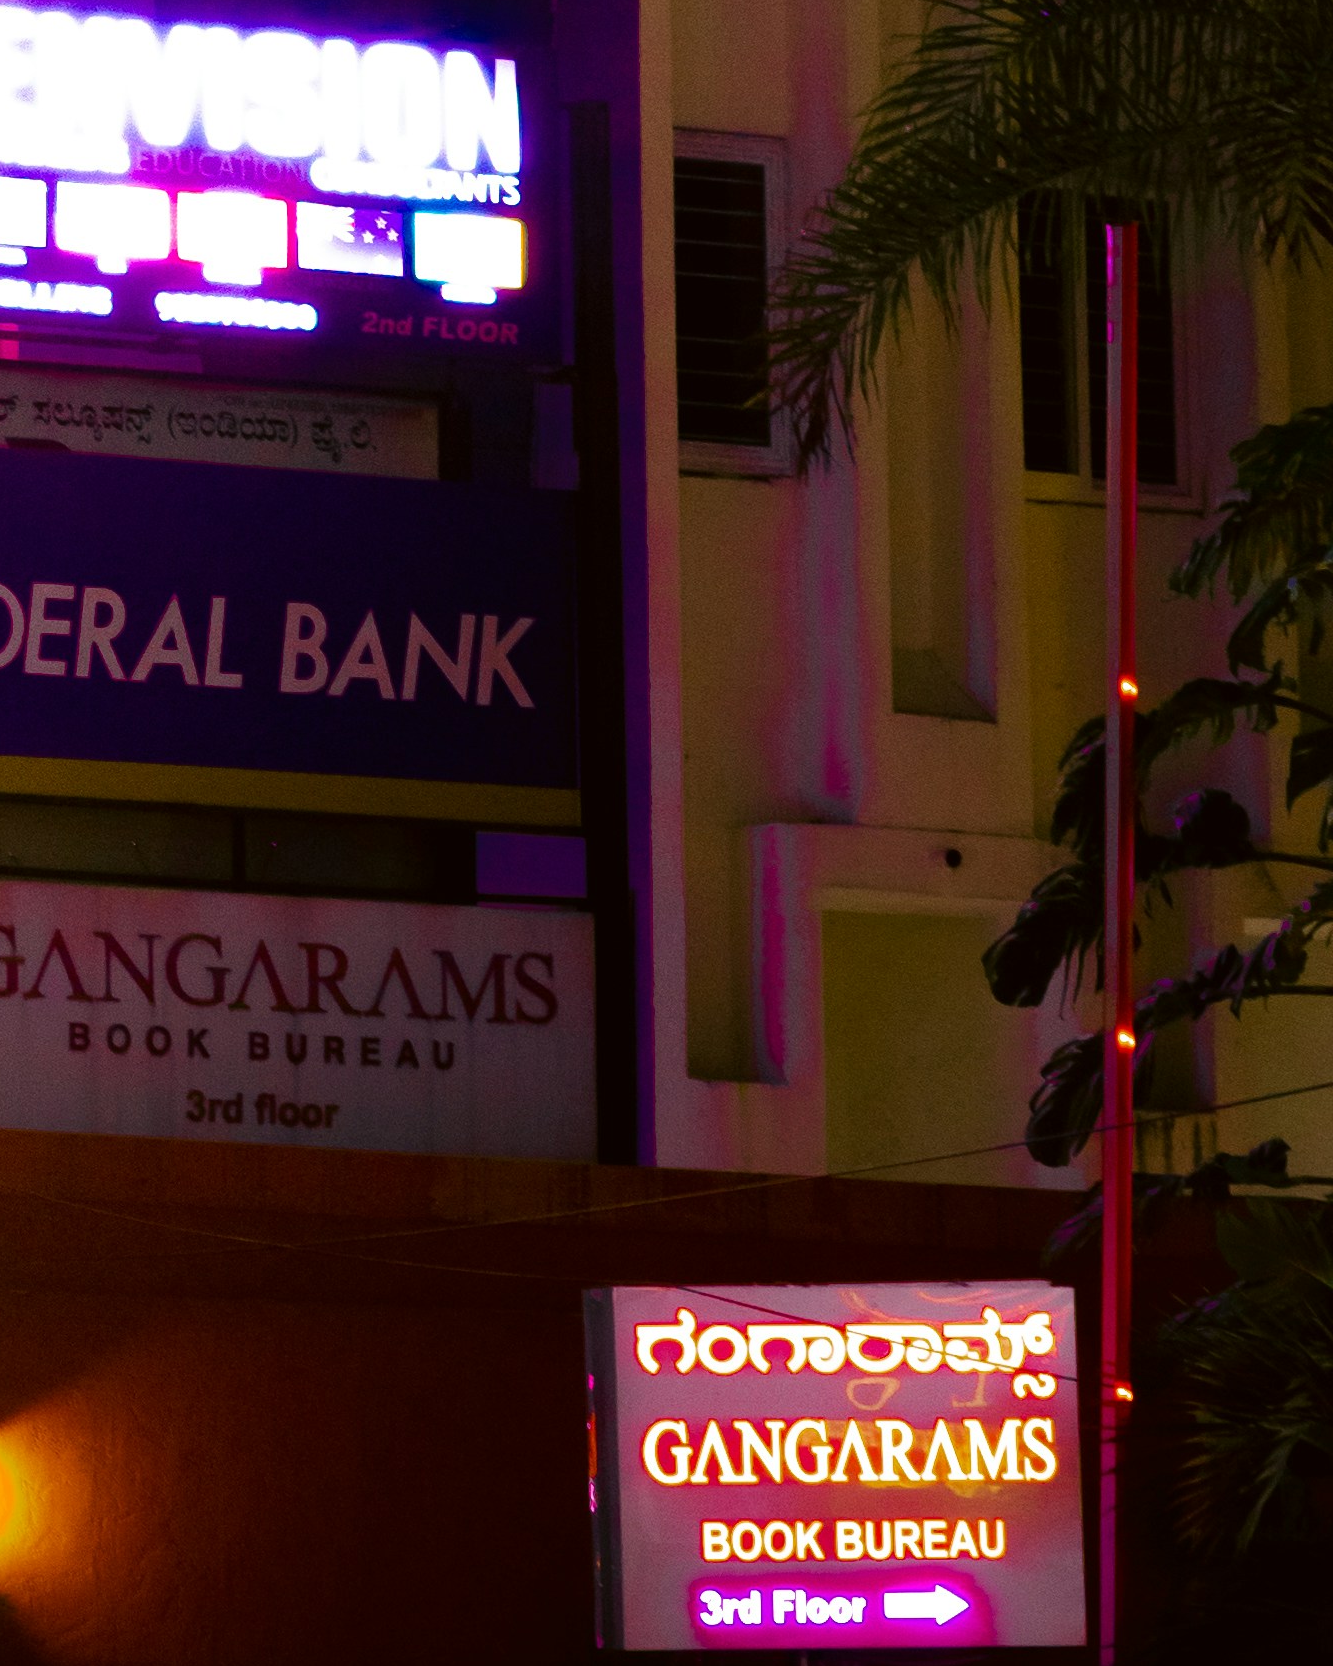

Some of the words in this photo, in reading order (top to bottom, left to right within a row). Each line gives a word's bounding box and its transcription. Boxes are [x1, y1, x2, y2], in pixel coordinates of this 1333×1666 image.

[136, 149, 306, 185] EDUCATION
[360, 311, 410, 337] 2nd
[422, 316, 519, 346] FLOOR
[278, 602, 534, 709] BANK
[69, 1021, 213, 1061] BOOK
[248, 1030, 457, 1072] BUREAU
[185, 1088, 245, 1128] 3rd
[254, 1091, 339, 1130] floor
[643, 1418, 1058, 1487] GANGARAMS
[701, 1520, 825, 1562] BOOK
[836, 1520, 1006, 1560] BUREAU
[699, 1590, 762, 1626] 3rd
[772, 1589, 867, 1624] Floor
